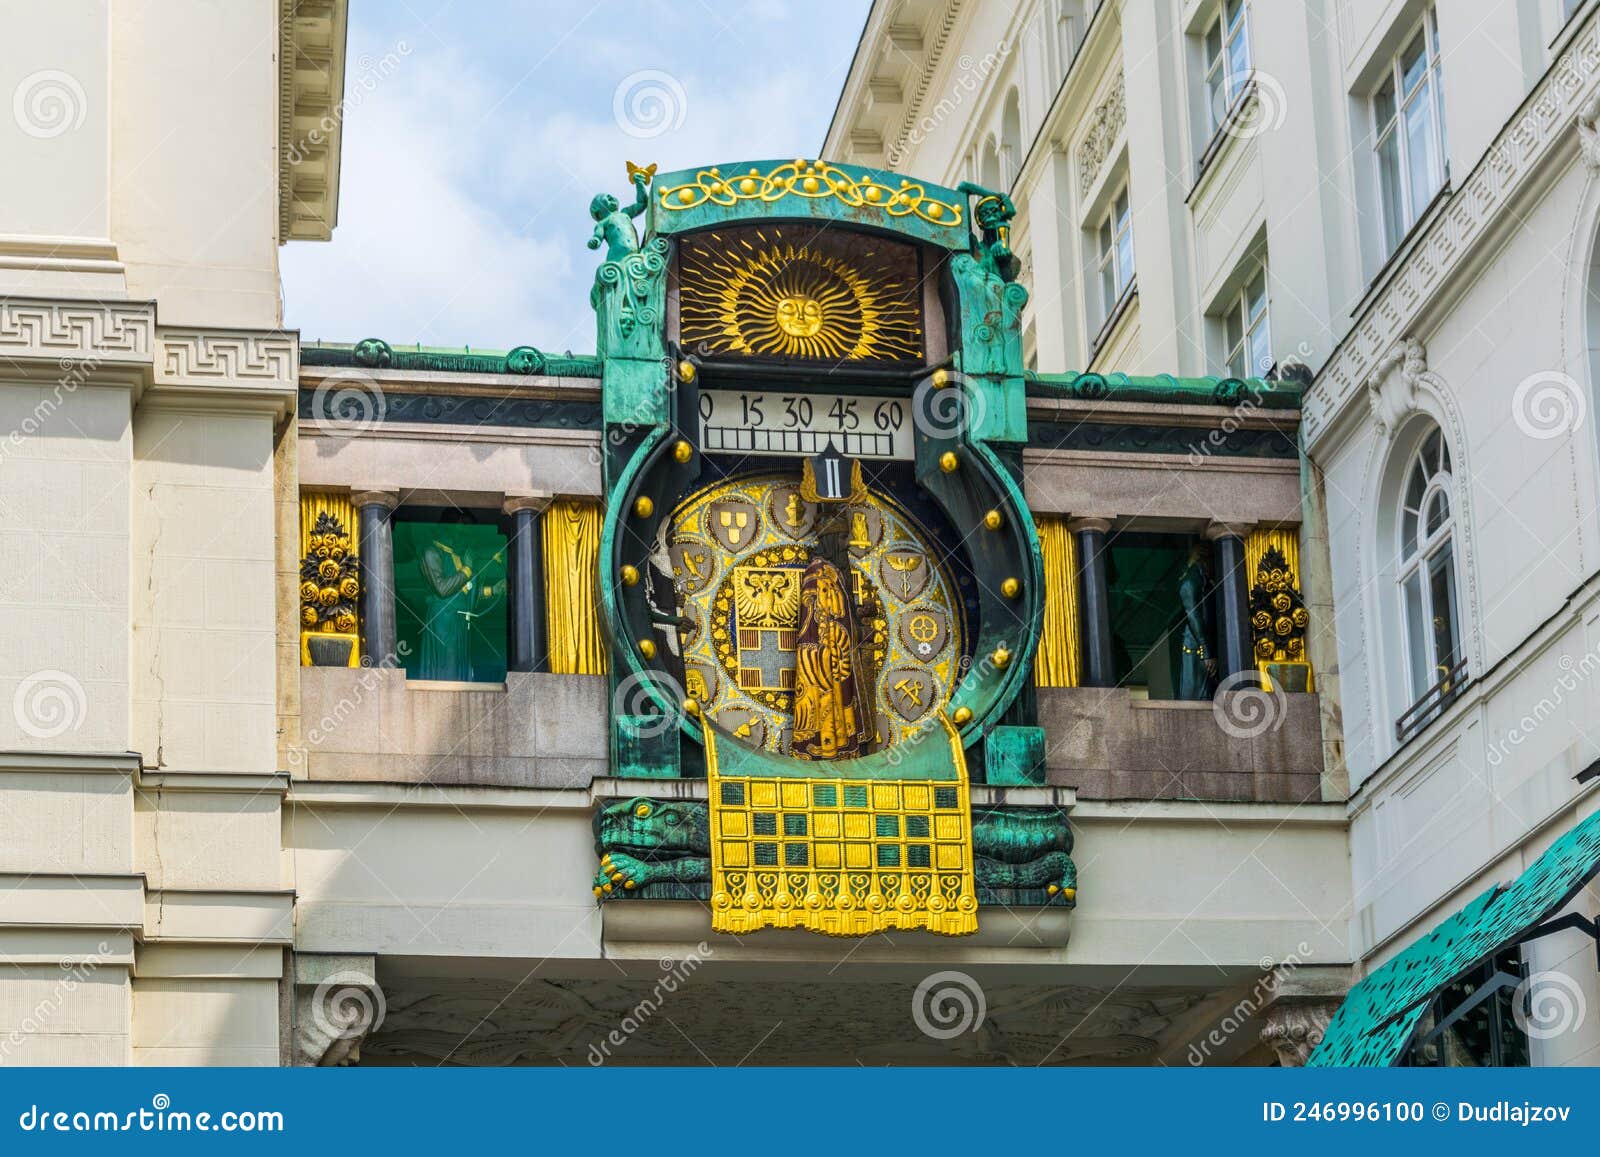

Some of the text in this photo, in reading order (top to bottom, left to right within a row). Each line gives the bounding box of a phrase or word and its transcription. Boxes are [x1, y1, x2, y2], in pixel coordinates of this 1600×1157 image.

[698, 391, 903, 432] 0 15 30 45 60
[825, 458, 843, 499] II
